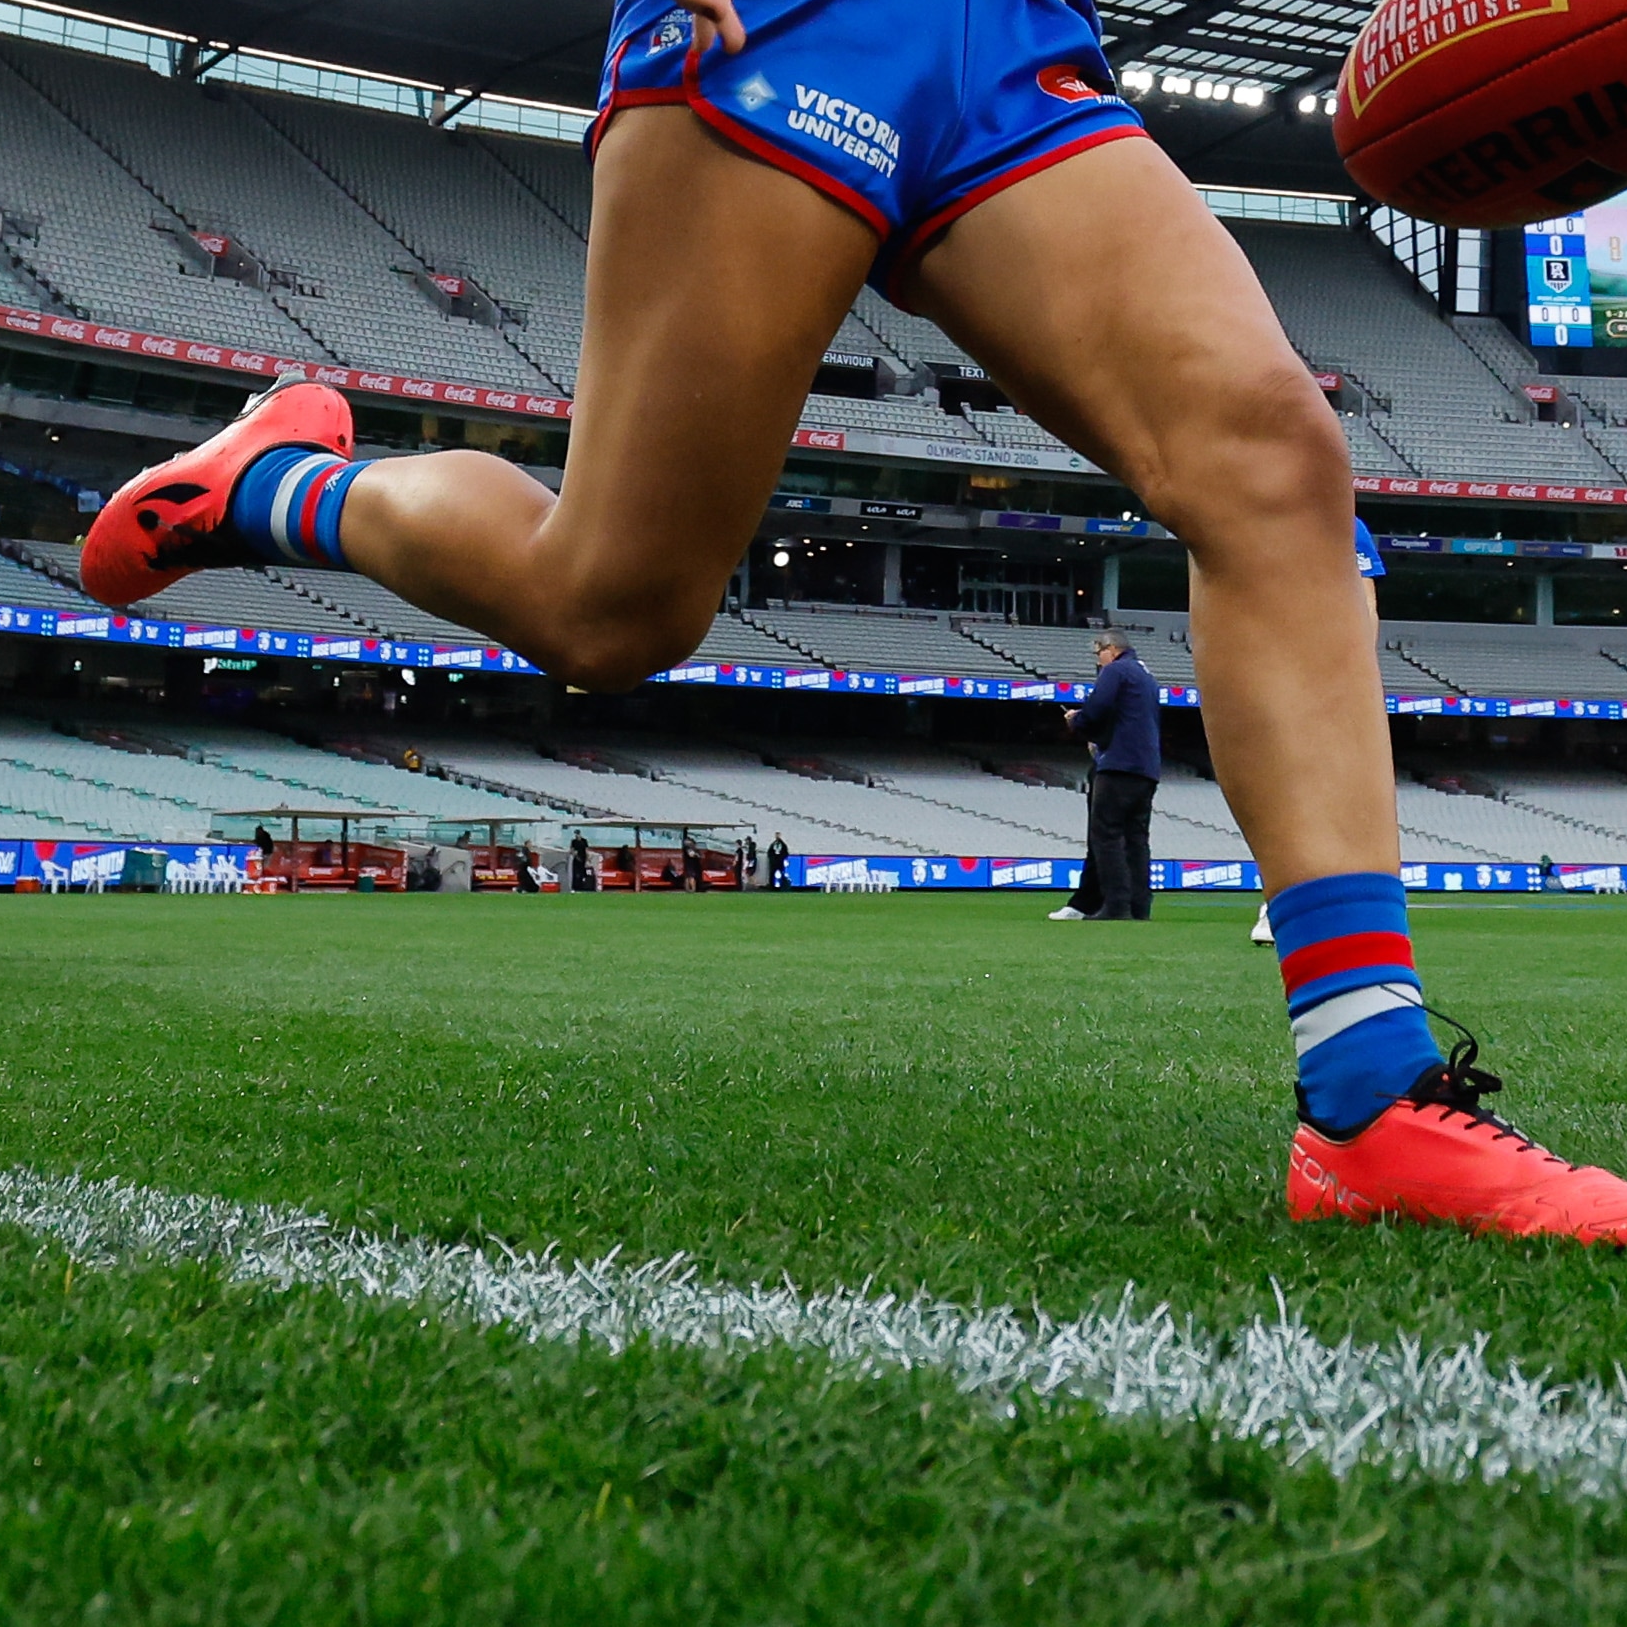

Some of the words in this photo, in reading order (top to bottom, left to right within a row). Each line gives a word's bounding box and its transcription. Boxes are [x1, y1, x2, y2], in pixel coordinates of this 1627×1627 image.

[795, 83, 901, 160] VICTORIA
[787, 109, 896, 179] UNIVERSITY
[1550, 235, 1563, 256] 0
[1555, 324, 1568, 346] 0
[823, 352, 874, 368] EHAVIOUR
[926, 444, 972, 460] OLYMPIC
[974, 449, 1011, 463] STAND
[1014, 453, 1039, 465] 2006
[56, 620, 76, 635] RISE
[76, 619, 96, 633] WITH
[96, 618, 109, 631] US
[992, 867, 1014, 887] RISE
[1014, 863, 1038, 882] WITH
[1038, 861, 1052, 878] US
[1182, 868, 1204, 888] RISE
[1204, 865, 1227, 884] WITH
[1227, 862, 1241, 879] US
[1413, 864, 1427, 881] US
